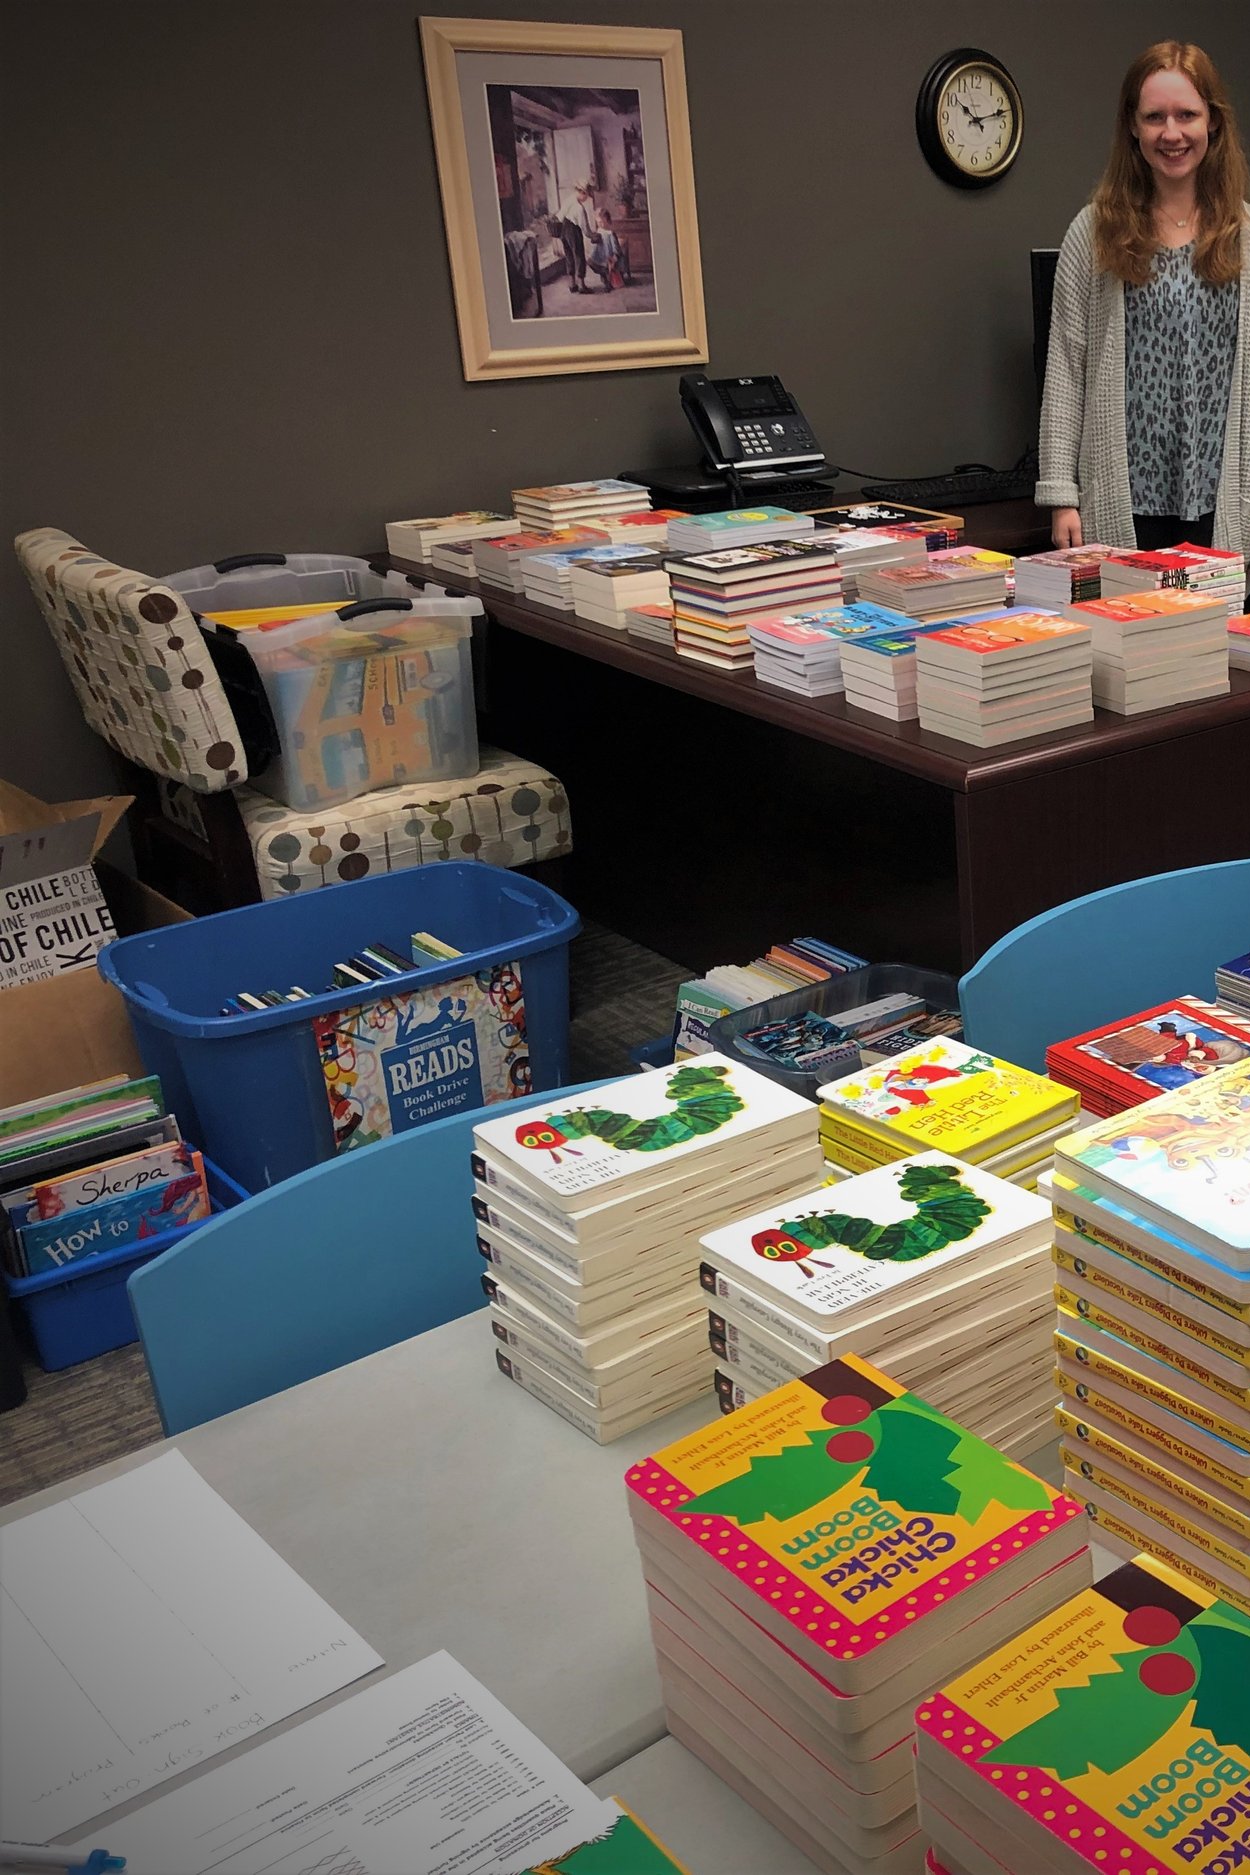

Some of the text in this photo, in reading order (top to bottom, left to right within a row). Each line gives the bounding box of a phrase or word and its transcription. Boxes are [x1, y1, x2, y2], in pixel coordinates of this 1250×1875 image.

[946, 92, 958, 107] 10
[970, 74, 982, 90] 12
[989, 82, 994, 96] 1
[942, 111, 949, 125] 9
[947, 130, 955, 145] 8
[970, 151, 978, 166] 6
[985, 146, 993, 161] 5
[995, 134, 1002, 149] 4
[5, 878, 64, 910] CHILE
[0, 905, 114, 964] OF CHILE
[6, 955, 52, 979] IN CHILE
[388, 1038, 474, 1096] READS
[403, 1076, 470, 1109] Book Drive
[408, 1091, 467, 1121] Challenge
[909, 1090, 996, 1129] Red Hen
[928, 1098, 1009, 1137] The Little
[76, 1167, 169, 1206] Sherpa
[42, 1218, 129, 1267] How to
[1094, 1398, 1208, 1470] Where Do Diggers Take Vacation?
[780, 1495, 882, 1555] Boom
[800, 1510, 902, 1570] Boom
[820, 1517, 934, 1588] Chicka
[840, 1532, 956, 1605] Chicka
[963, 1606, 1096, 1700] illustrated by Lois Ehlert
[985, 1620, 1106, 1708] and John Archambault
[1014, 1639, 1104, 1704] by Bill Martin Jr
[1115, 1737, 1224, 1819] Boom
